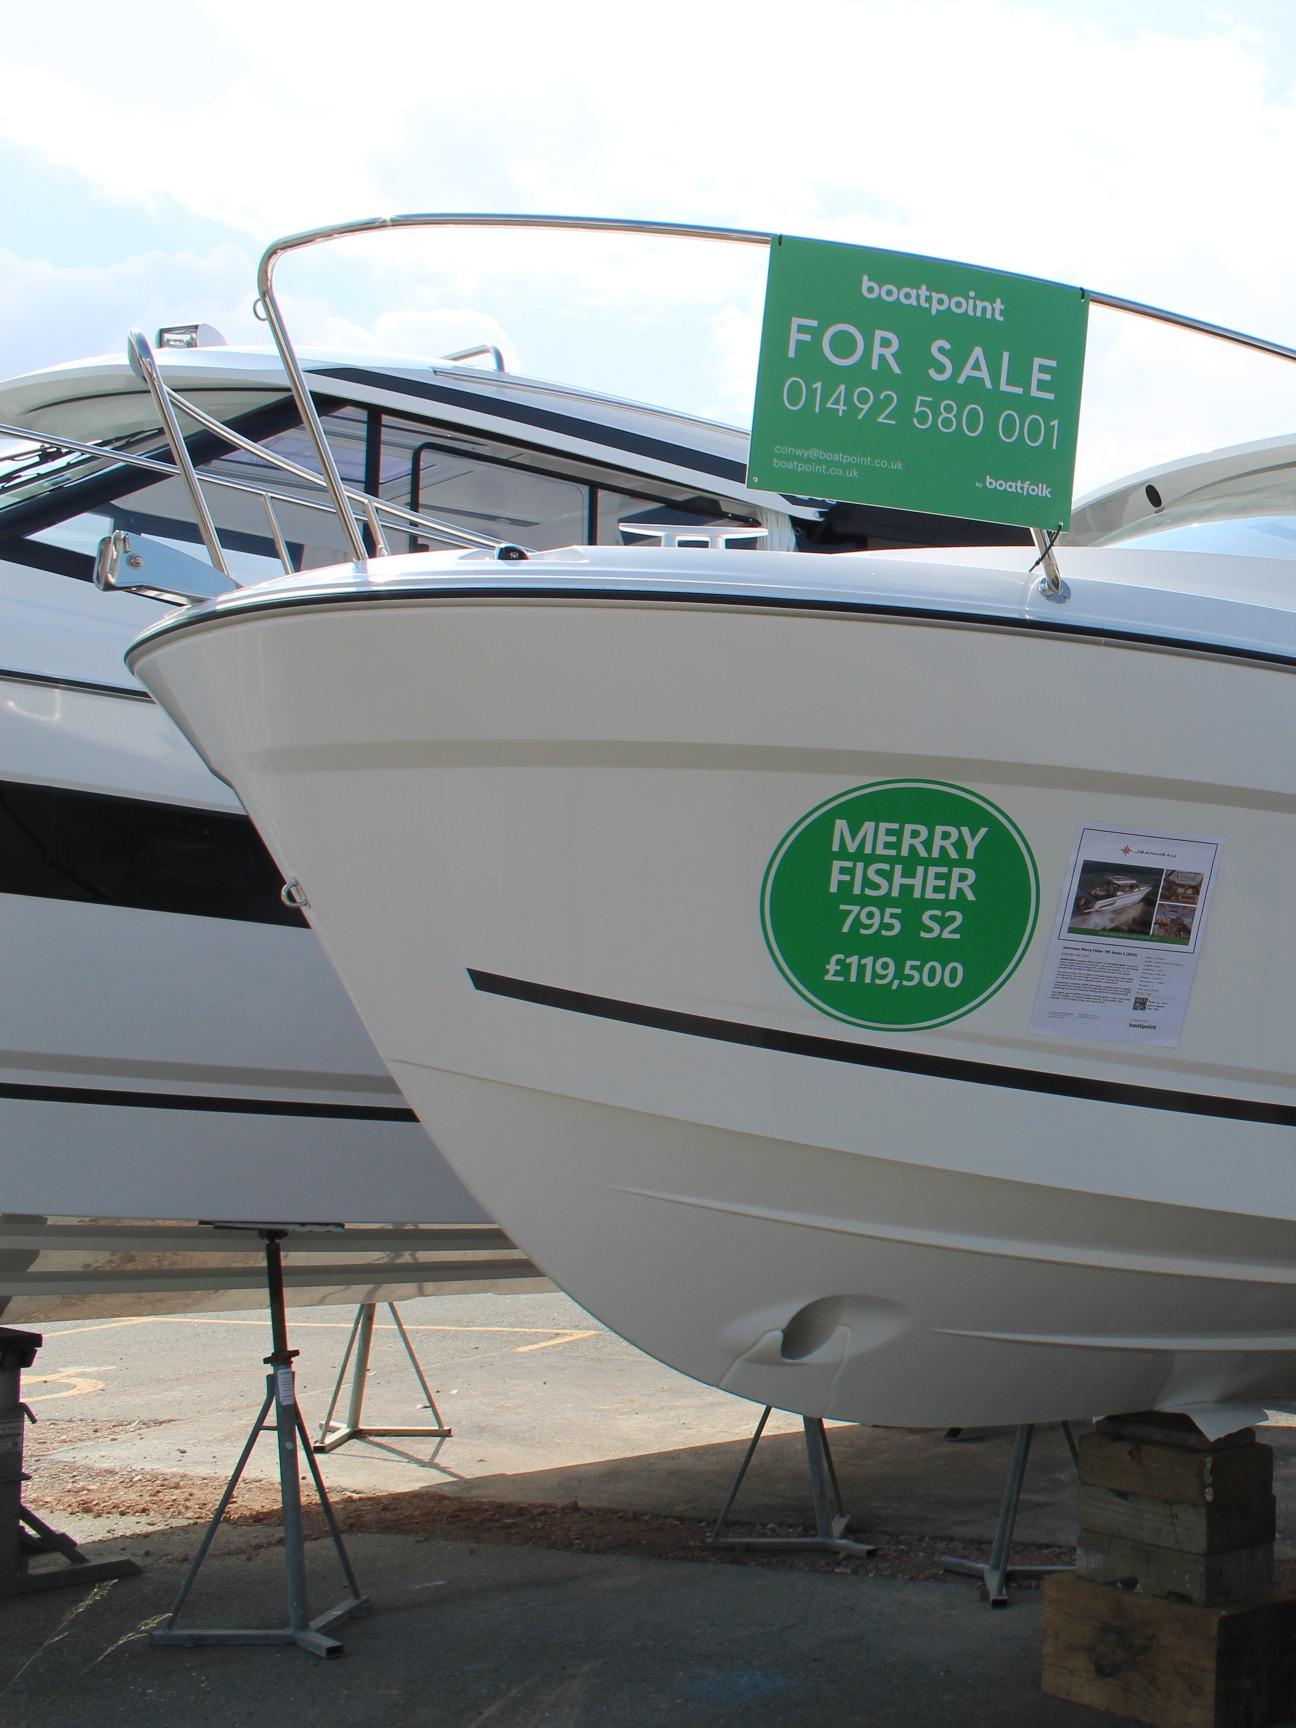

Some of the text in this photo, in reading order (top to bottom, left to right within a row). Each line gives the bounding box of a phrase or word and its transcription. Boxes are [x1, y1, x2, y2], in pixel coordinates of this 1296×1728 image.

[861, 274, 1005, 321] boatpoint
[787, 316, 1058, 401] FOR SALE
[782, 377, 1060, 450] 01492 580 001
[772, 458, 859, 478] boatpoint.co.uk
[773, 445, 904, 471] conwy@boatpoint.co.uk
[986, 475, 1052, 498] boatfolk
[831, 818, 989, 860] MERRY
[829, 860, 977, 901] FISHER
[839, 904, 964, 940] 795 S2
[823, 953, 964, 990] £119,500
